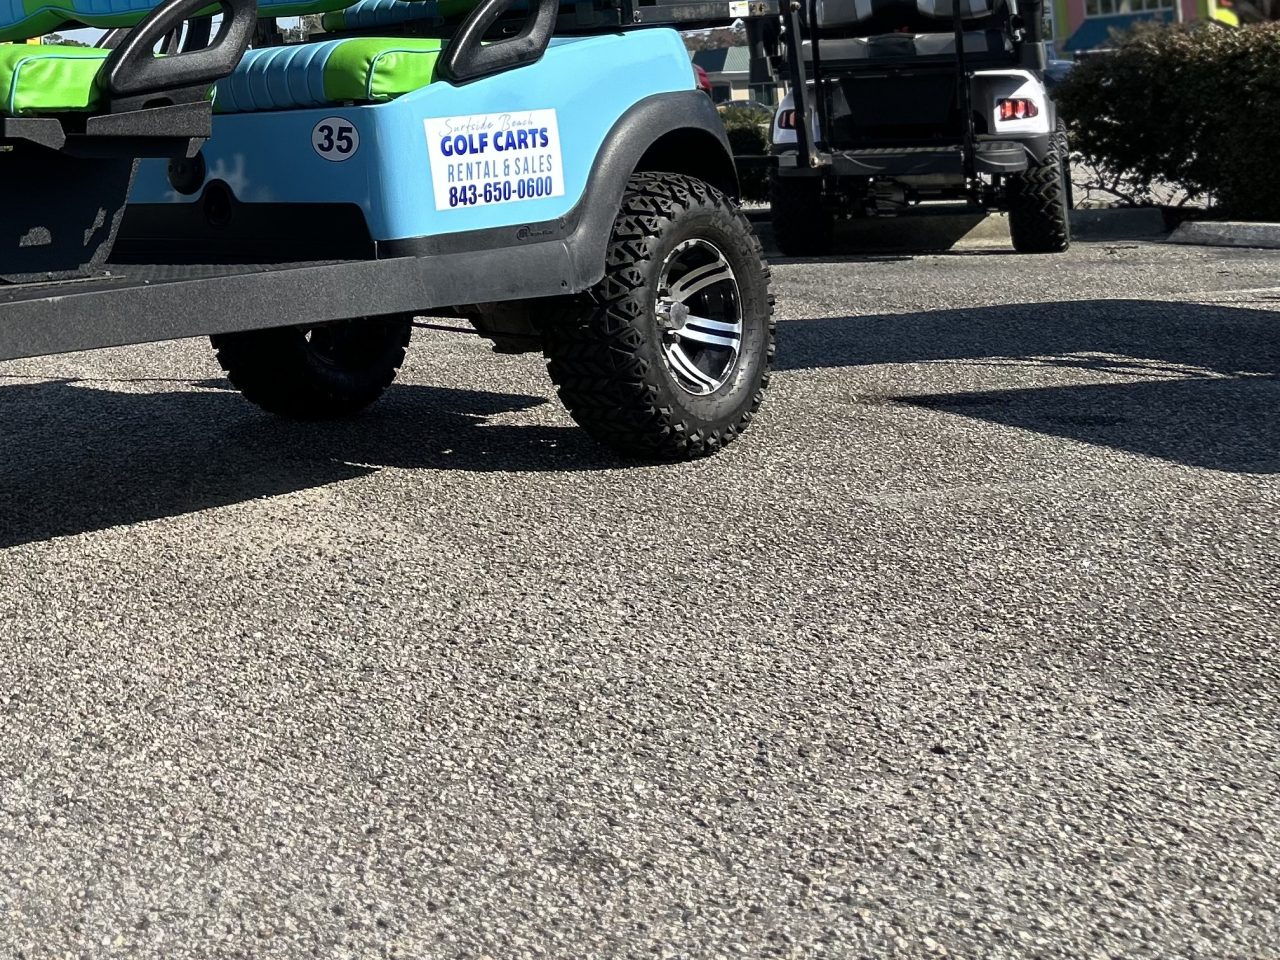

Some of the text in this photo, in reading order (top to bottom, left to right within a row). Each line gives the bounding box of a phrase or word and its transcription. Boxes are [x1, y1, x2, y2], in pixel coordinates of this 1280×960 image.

[438, 112, 534, 137] Surfside Beach
[317, 125, 353, 154] 35
[440, 127, 549, 157] GOLF CARTS
[447, 154, 553, 182] RENTAL & SALES
[448, 176, 553, 207] 843-650-0600
